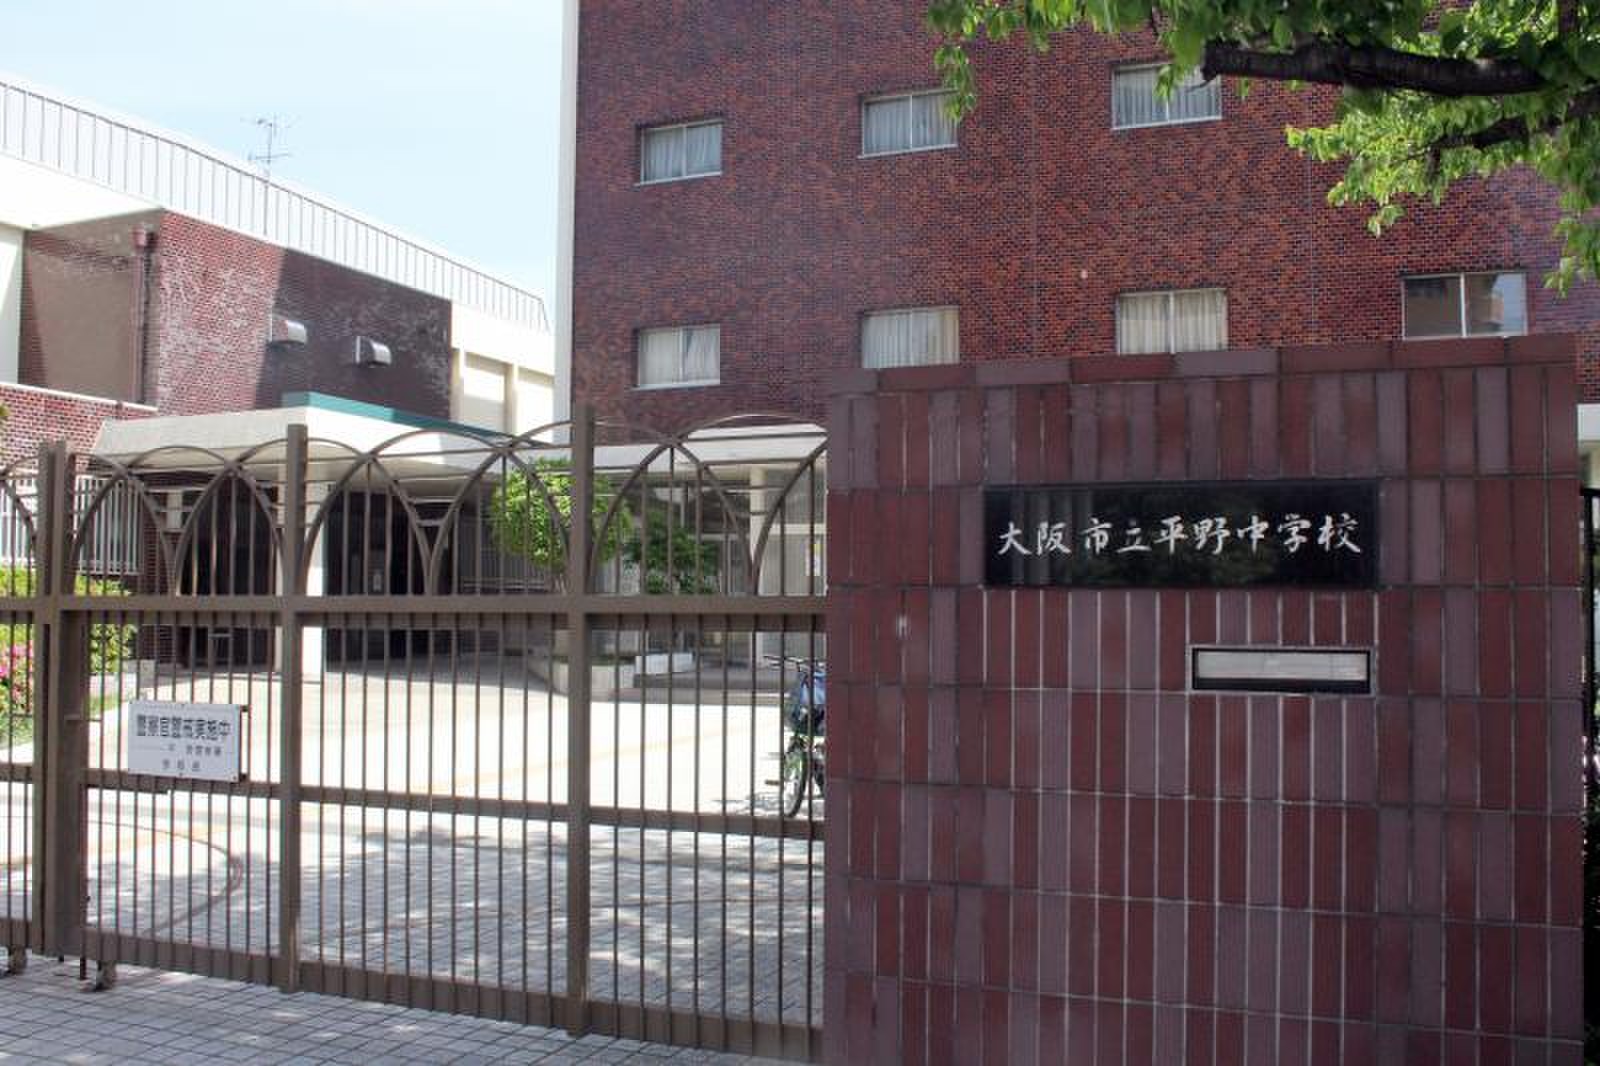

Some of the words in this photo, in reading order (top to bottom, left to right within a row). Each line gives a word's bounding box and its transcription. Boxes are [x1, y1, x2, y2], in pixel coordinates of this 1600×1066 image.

[997, 513, 1361, 556] 大阪市立平野中学校
